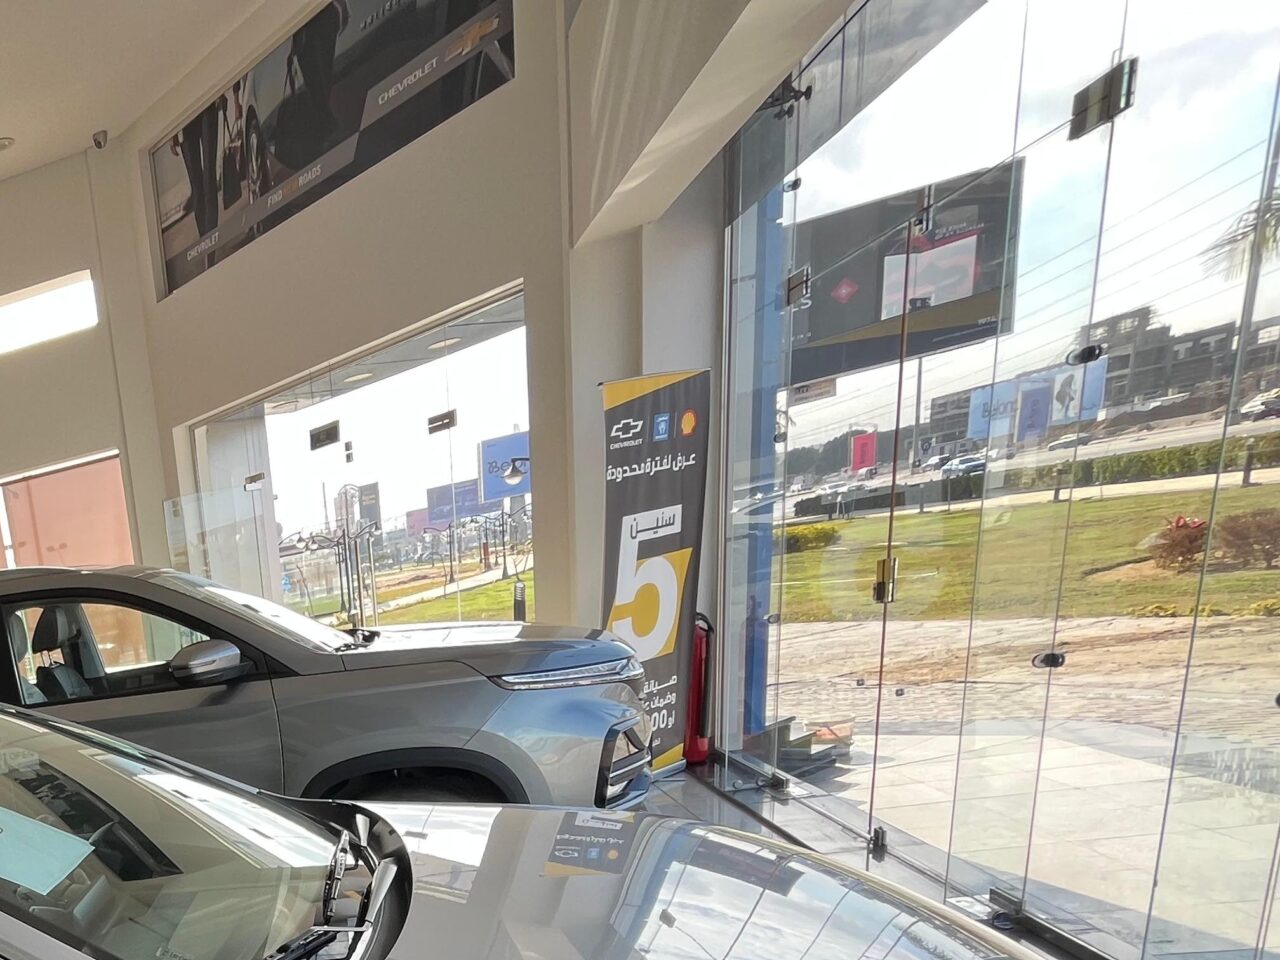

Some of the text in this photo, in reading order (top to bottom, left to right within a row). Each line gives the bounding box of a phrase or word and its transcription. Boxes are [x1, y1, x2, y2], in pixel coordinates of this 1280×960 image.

[378, 56, 439, 105] CHEVROLET
[267, 190, 283, 208] FIND
[298, 164, 322, 187] ROADS
[186, 231, 219, 261] CHEVROLET
[609, 438, 644, 450] CHEVROLET
[606, 452, 696, 483] عرض لفترة محدودة
[630, 511, 676, 539] سنين
